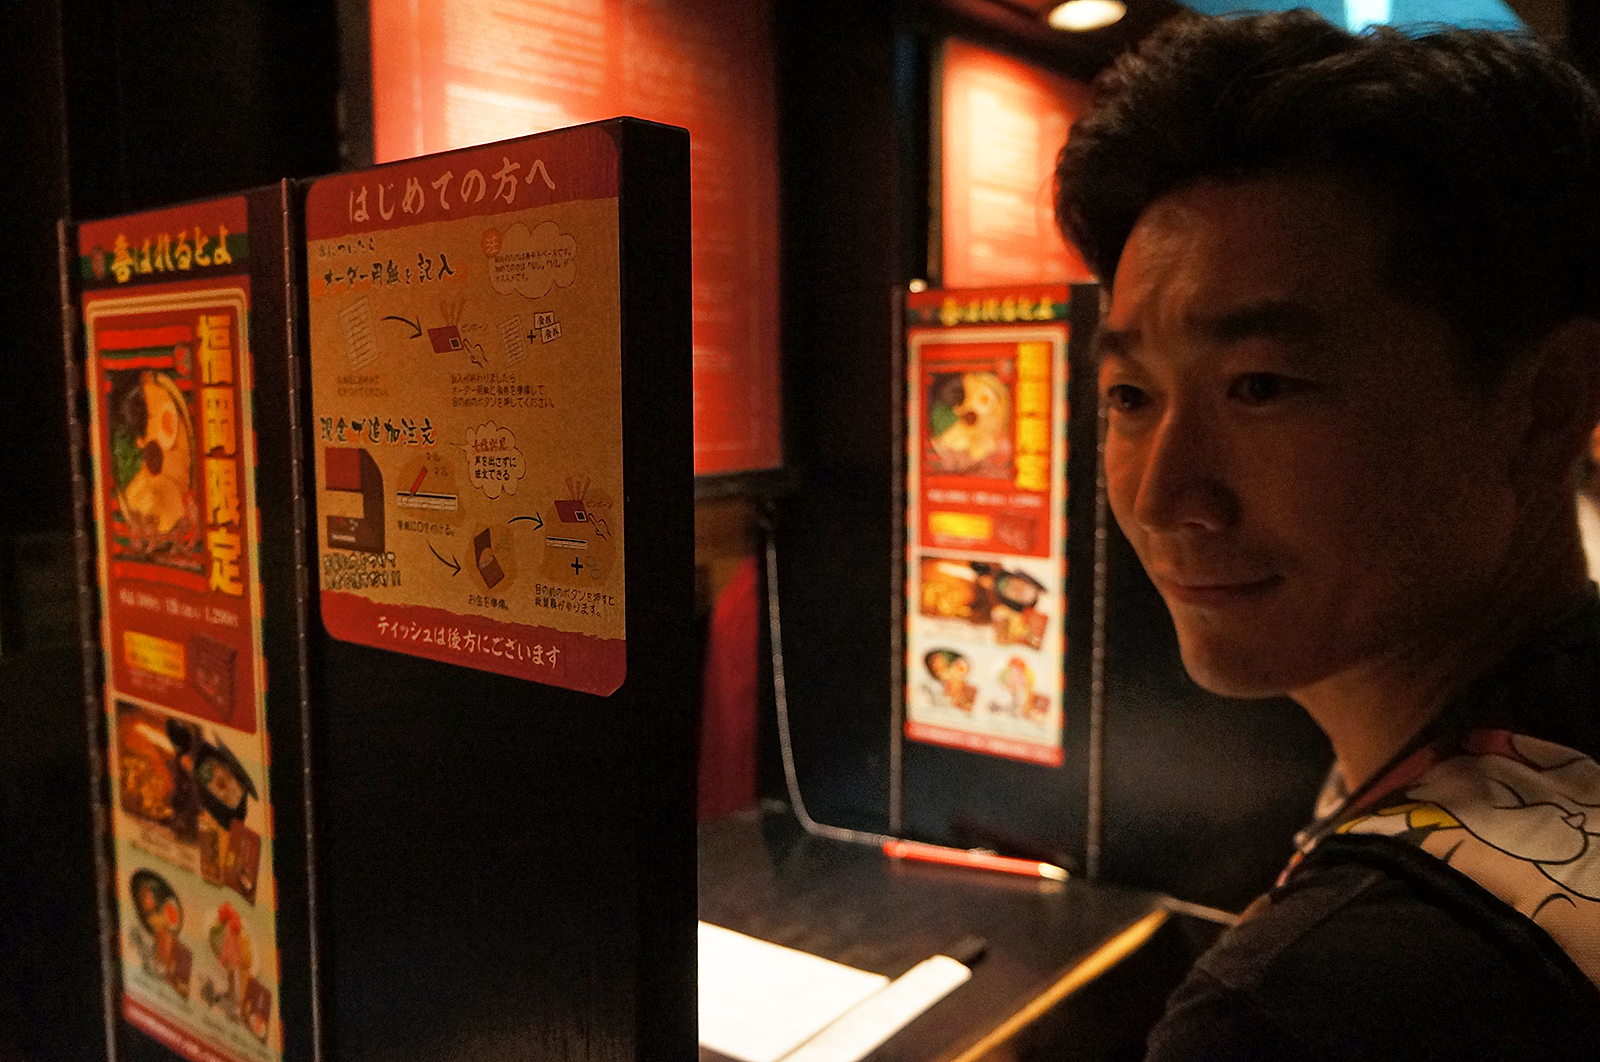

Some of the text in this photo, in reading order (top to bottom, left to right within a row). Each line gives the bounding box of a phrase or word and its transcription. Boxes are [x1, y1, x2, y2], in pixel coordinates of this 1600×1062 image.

[349, 156, 556, 224] はじめての方へ
[377, 616, 561, 669] ティッシュは後方にございます
